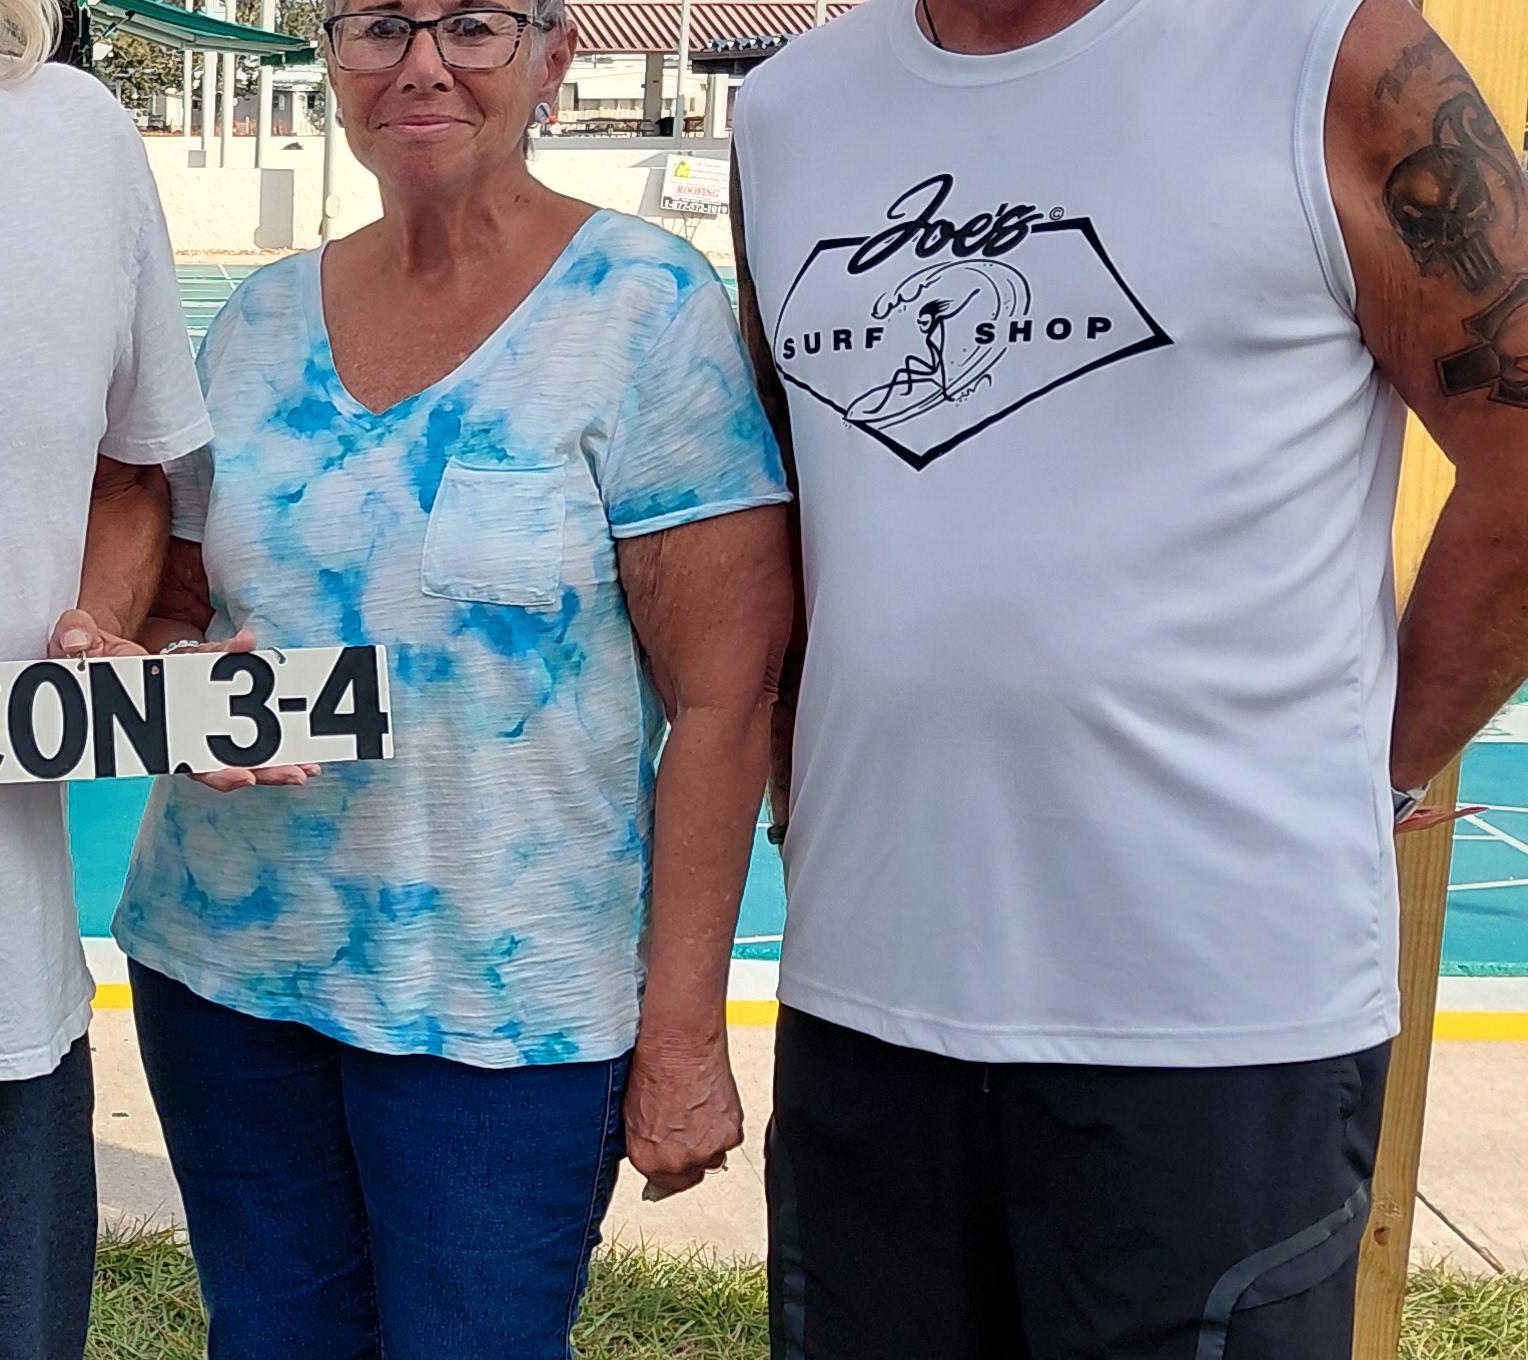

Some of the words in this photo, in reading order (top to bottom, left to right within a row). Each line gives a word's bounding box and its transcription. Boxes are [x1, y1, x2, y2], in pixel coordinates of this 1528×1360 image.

[847, 173, 1043, 274] Joe's
[782, 326, 884, 359] SURF
[974, 317, 1112, 344] SHOP
[206, 645, 389, 767] 3-4
